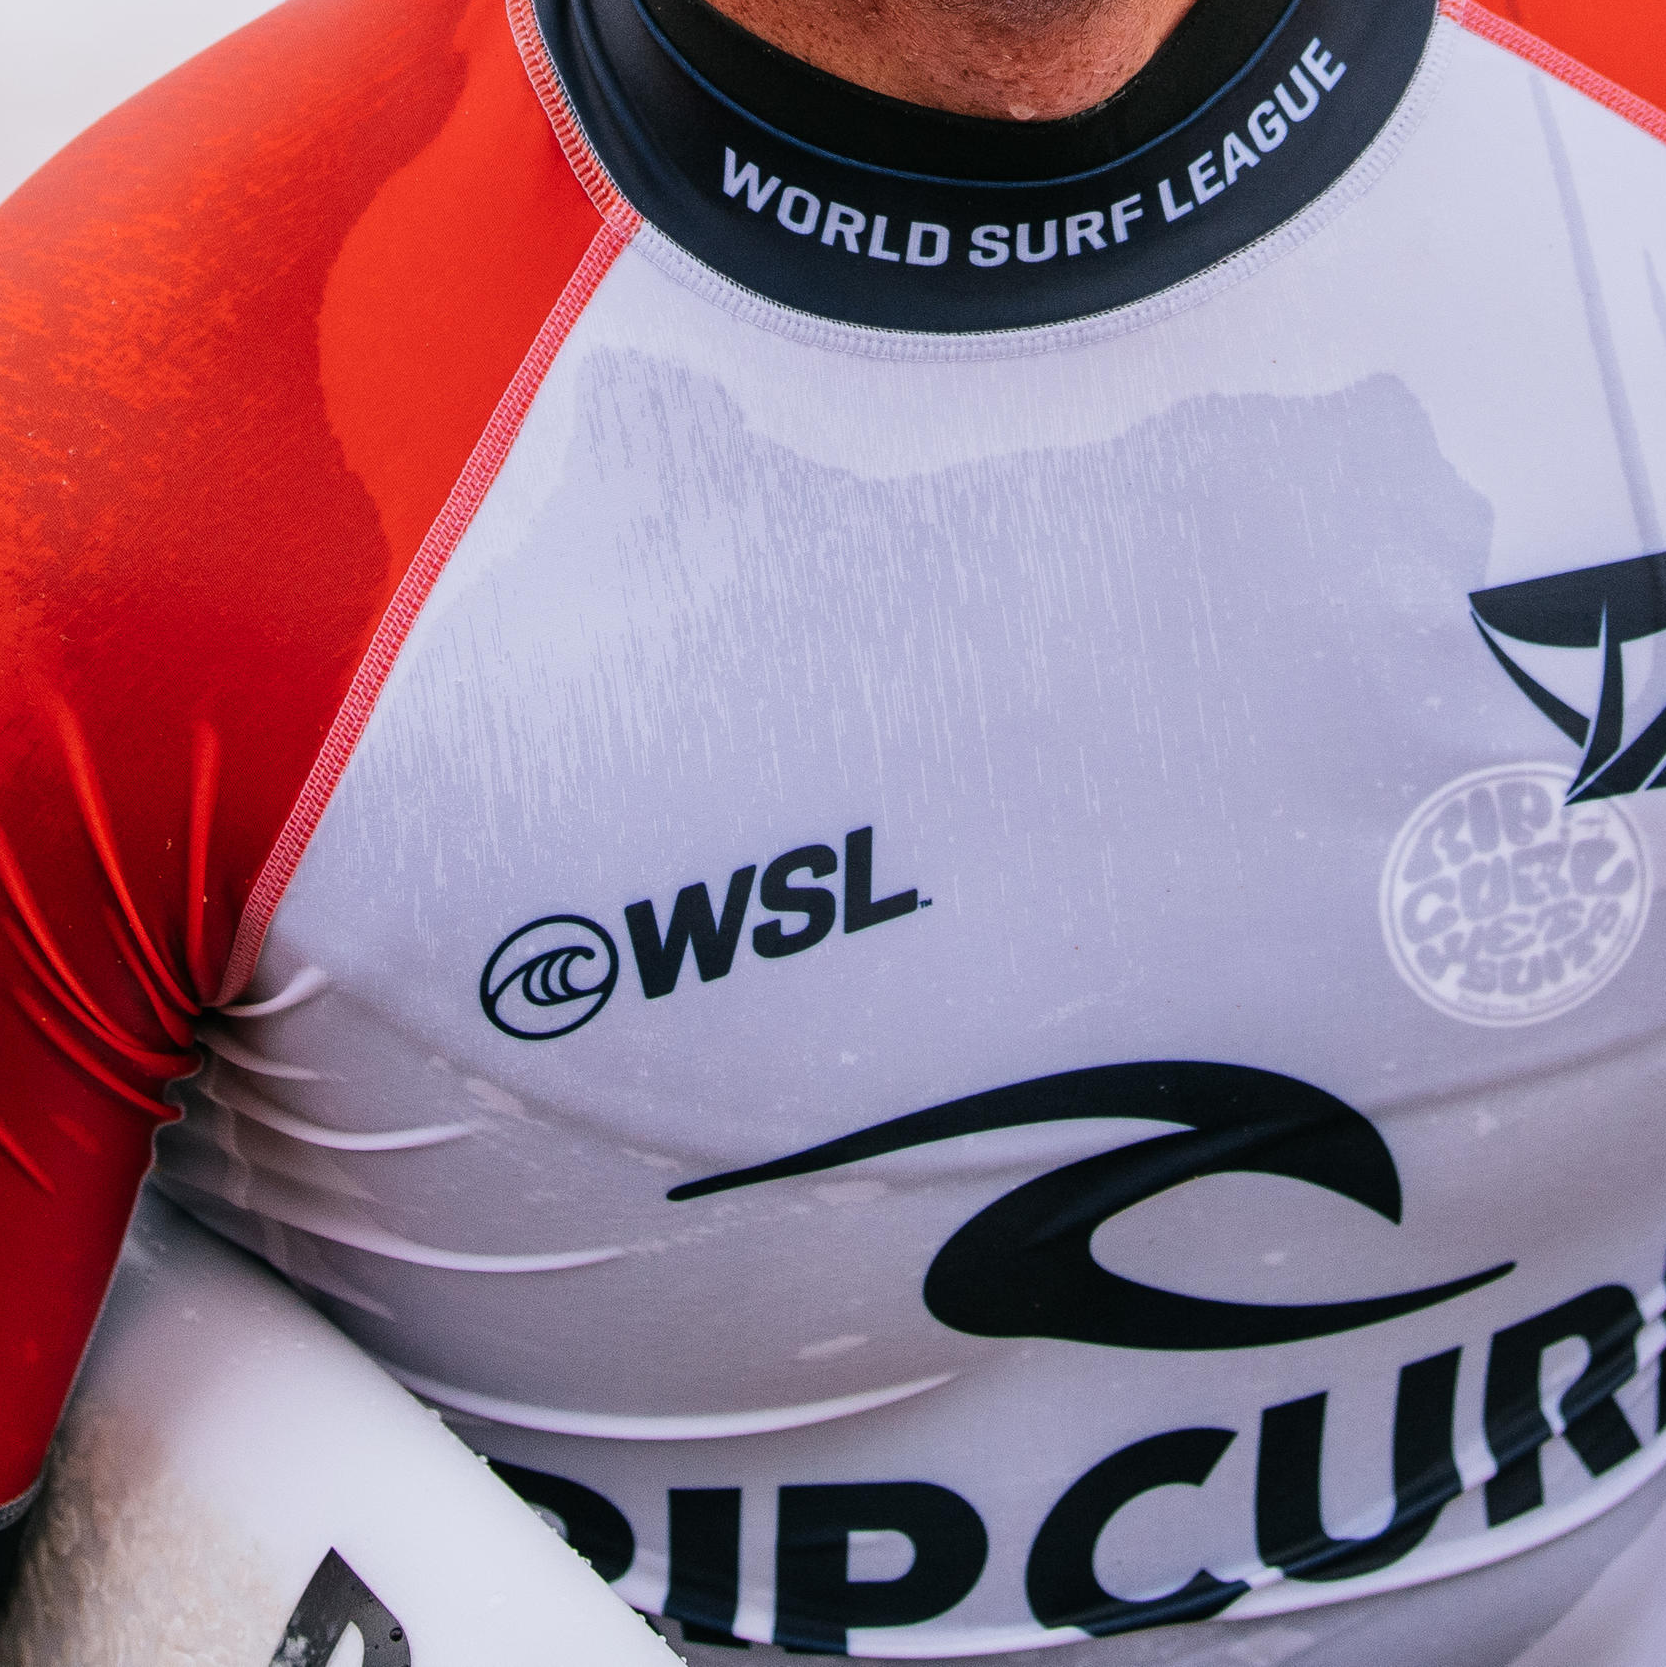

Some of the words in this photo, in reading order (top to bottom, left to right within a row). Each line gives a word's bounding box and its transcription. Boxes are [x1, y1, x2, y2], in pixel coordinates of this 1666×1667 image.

[723, 145, 951, 267] WORLD
[968, 194, 1145, 268] SURF
[1157, 37, 1347, 223] LEAGUE
